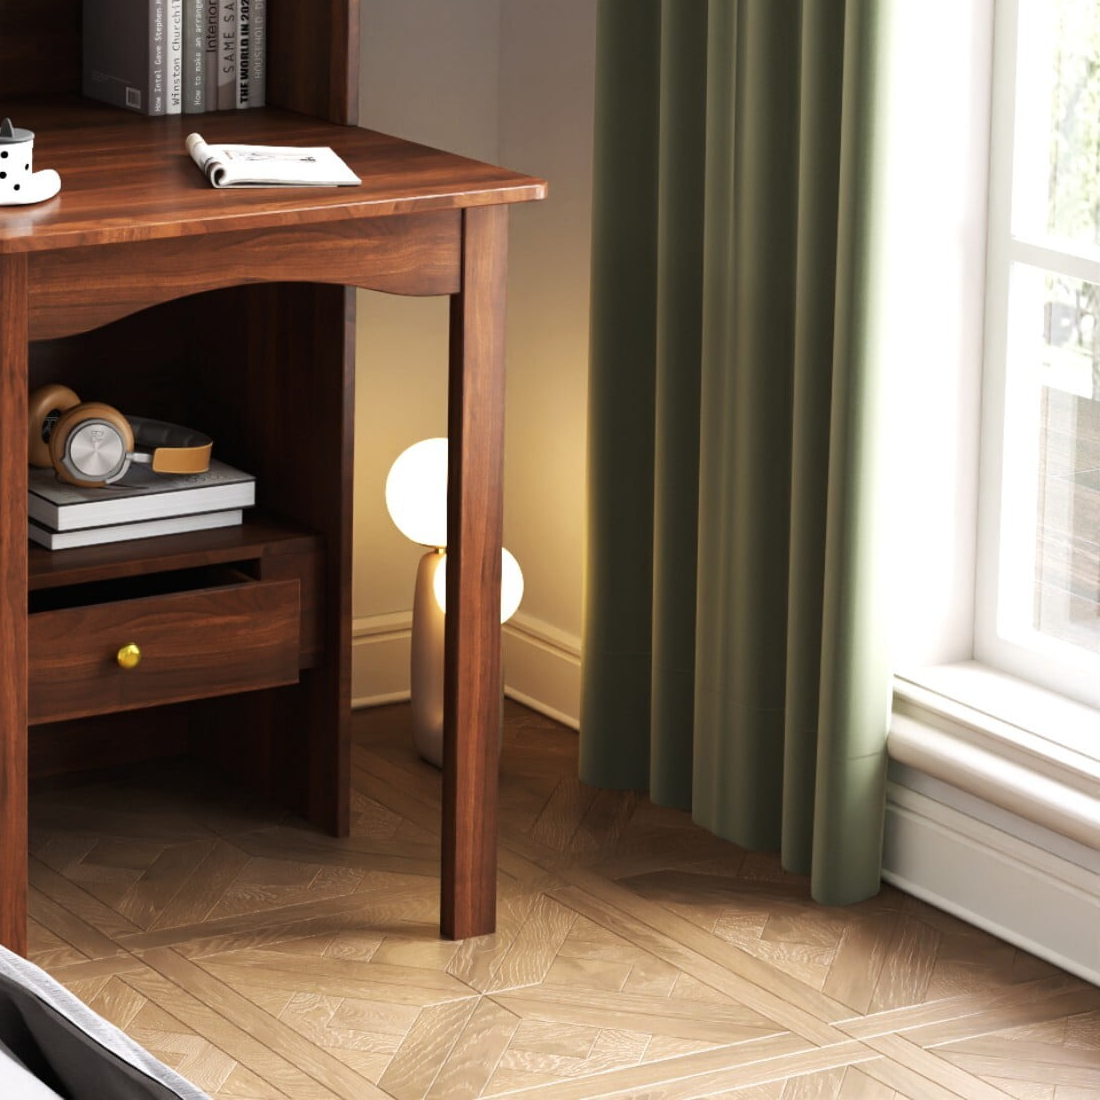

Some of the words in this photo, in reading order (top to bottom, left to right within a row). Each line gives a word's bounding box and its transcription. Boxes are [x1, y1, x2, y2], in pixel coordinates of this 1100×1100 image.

[240, 22, 250, 36] IN
[223, 31, 235, 74] SAME
[239, 38, 250, 80] WORLD
[172, 57, 181, 106] Winston
[239, 81, 250, 104] THE
